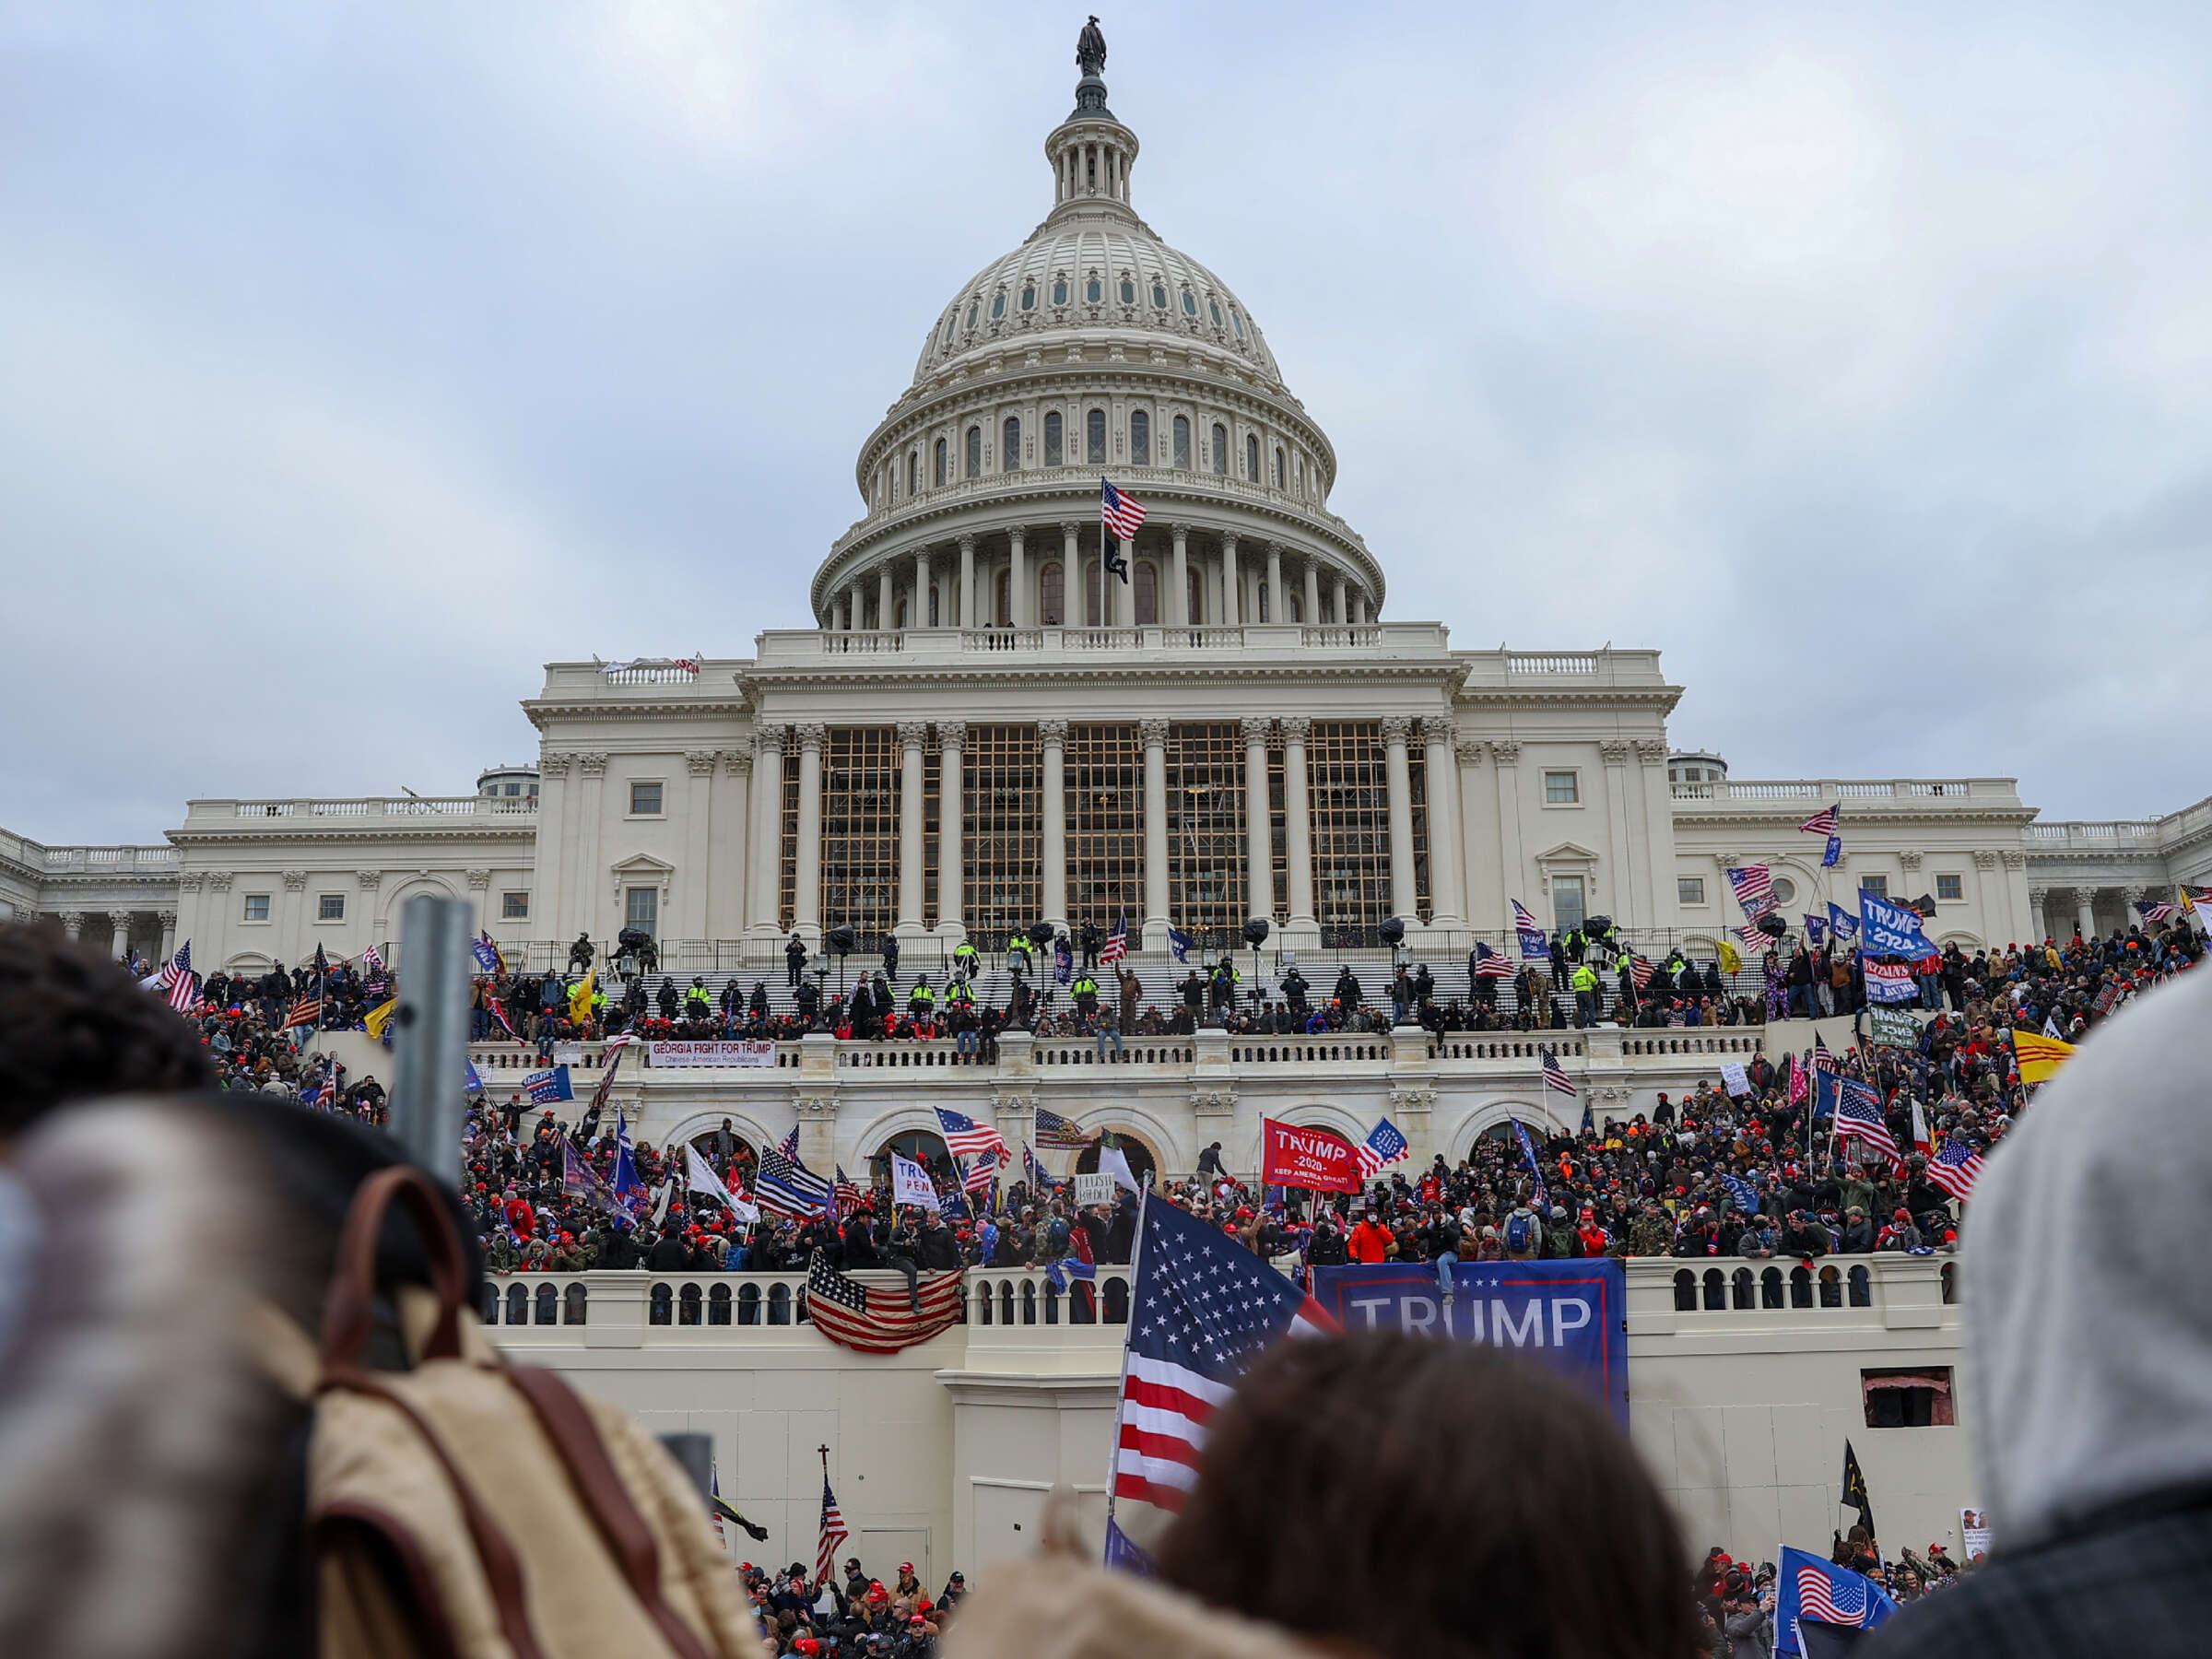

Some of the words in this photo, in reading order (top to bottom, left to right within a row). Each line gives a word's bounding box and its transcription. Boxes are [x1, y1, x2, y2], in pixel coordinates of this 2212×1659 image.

[1864, 899, 1921, 935] TRUMP
[1873, 926, 1916, 950] 2024
[653, 1043, 691, 1054] GEORGIA
[694, 1043, 718, 1053] FIGHT
[722, 1043, 738, 1053] FOR
[741, 1043, 771, 1054] TRUMP
[723, 1055, 759, 1064] Republicans
[1276, 1130, 1347, 1161] TRUMP
[899, 1162, 932, 1180] TRU
[1293, 1171, 1322, 1182] AMERICA
[907, 1180, 935, 1194] PEN
[1350, 1296, 1592, 1348] TRUMP
